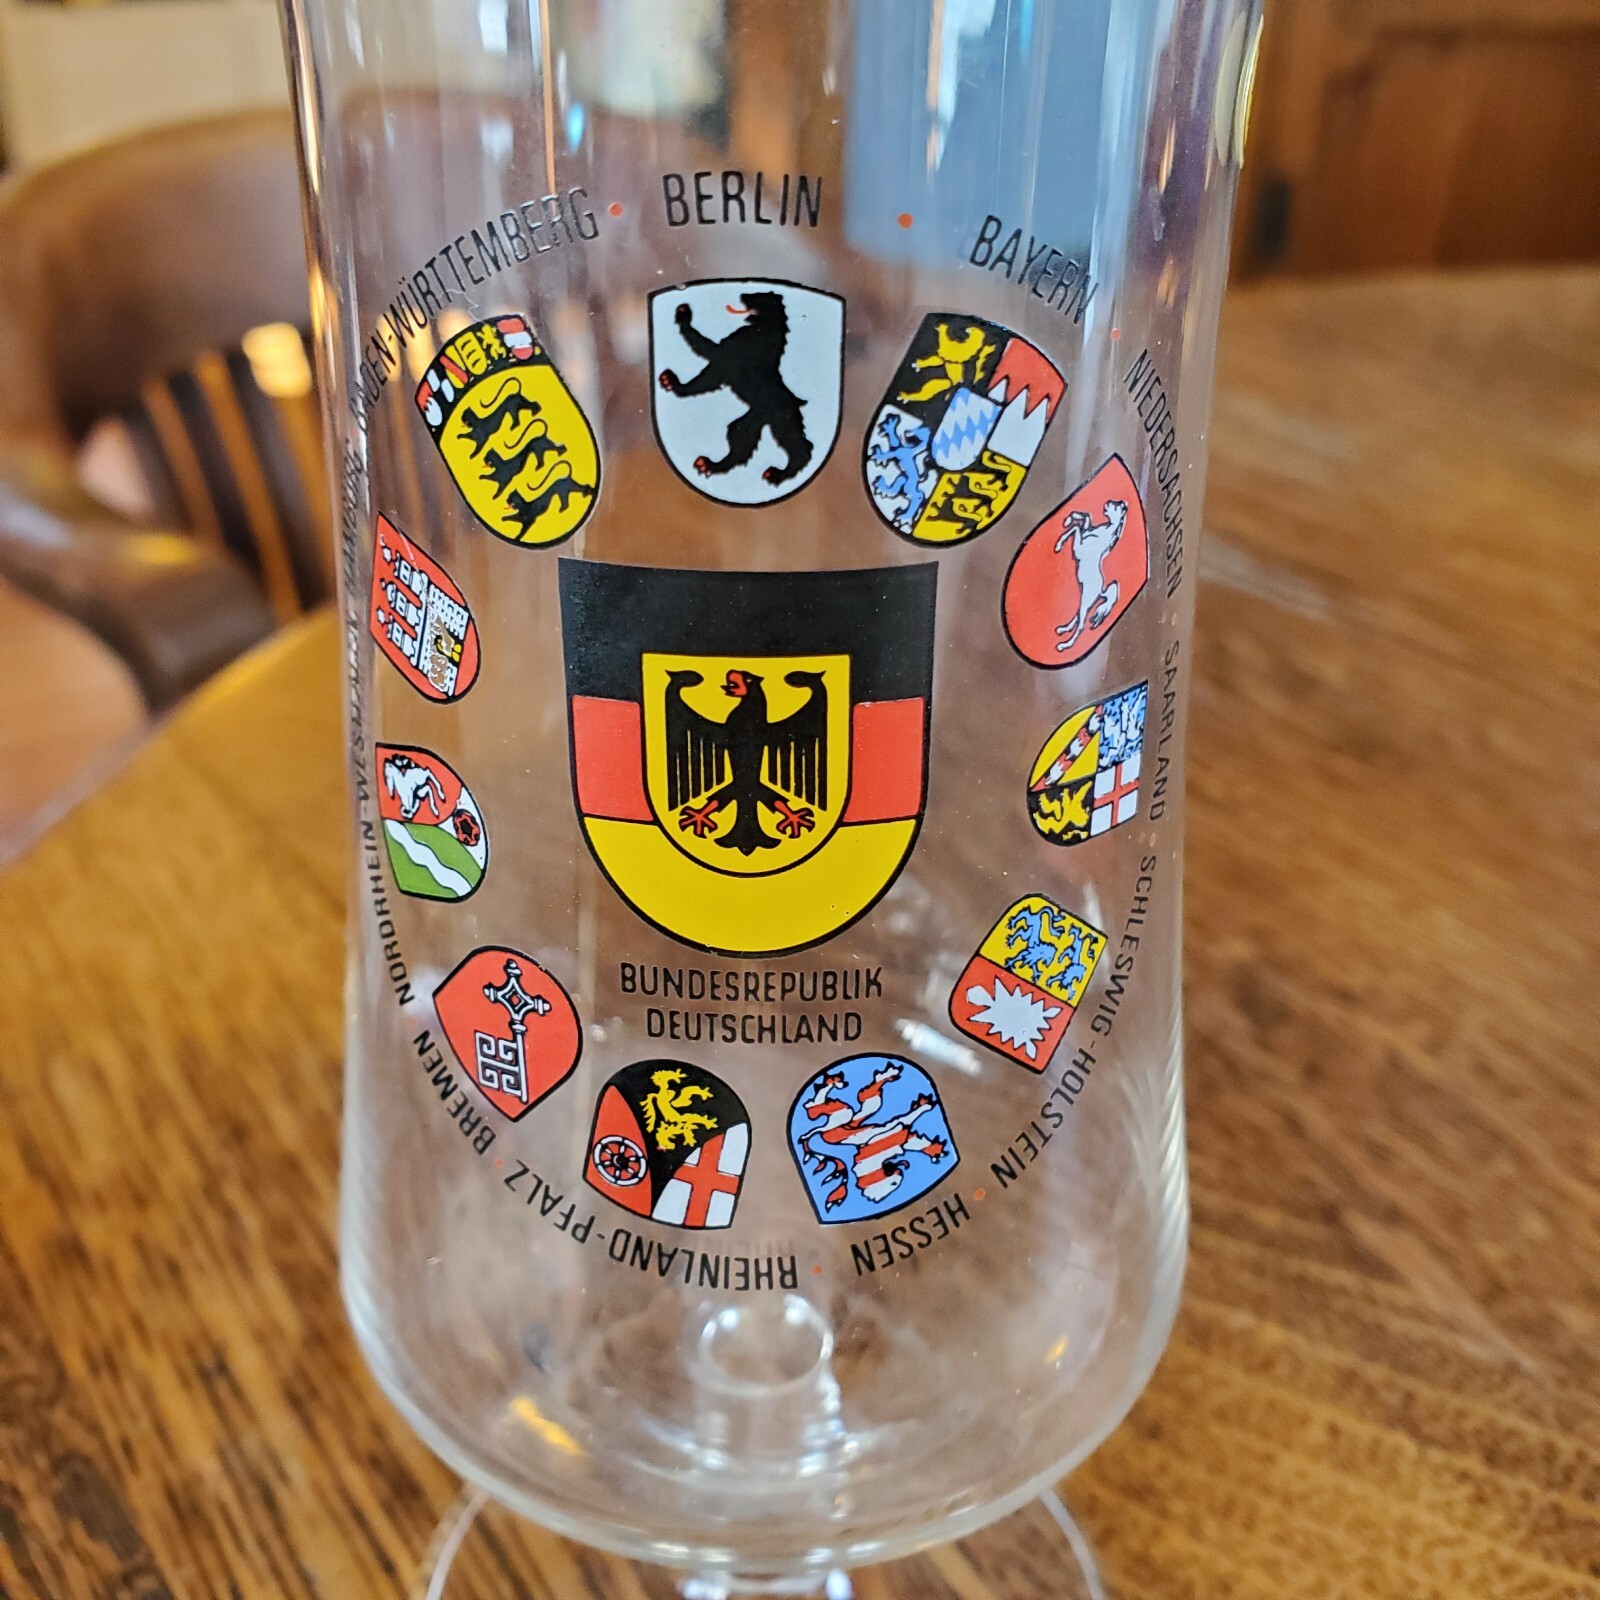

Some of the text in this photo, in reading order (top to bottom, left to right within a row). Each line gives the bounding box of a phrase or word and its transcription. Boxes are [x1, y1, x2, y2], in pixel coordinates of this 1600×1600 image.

[662, 170, 823, 228] BERLIN
[349, 186, 600, 435] BADEN-WÜRTTEMBERG
[969, 214, 1099, 325] BAYERN
[1123, 348, 1185, 599] NIEDERSACHSEN
[1149, 639, 1180, 821] SAARLAND
[620, 961, 883, 1002] BUNDESREPUBLIK
[646, 1007, 862, 1044] DEUTSCHLAND
[990, 855, 1157, 1189] SCHLESWIG-HOLSTEIN
[413, 1029, 497, 1155] BREMEN
[503, 1158, 799, 1290] RHEINLAND-PFALZ
[850, 1193, 971, 1276] HESSEN
